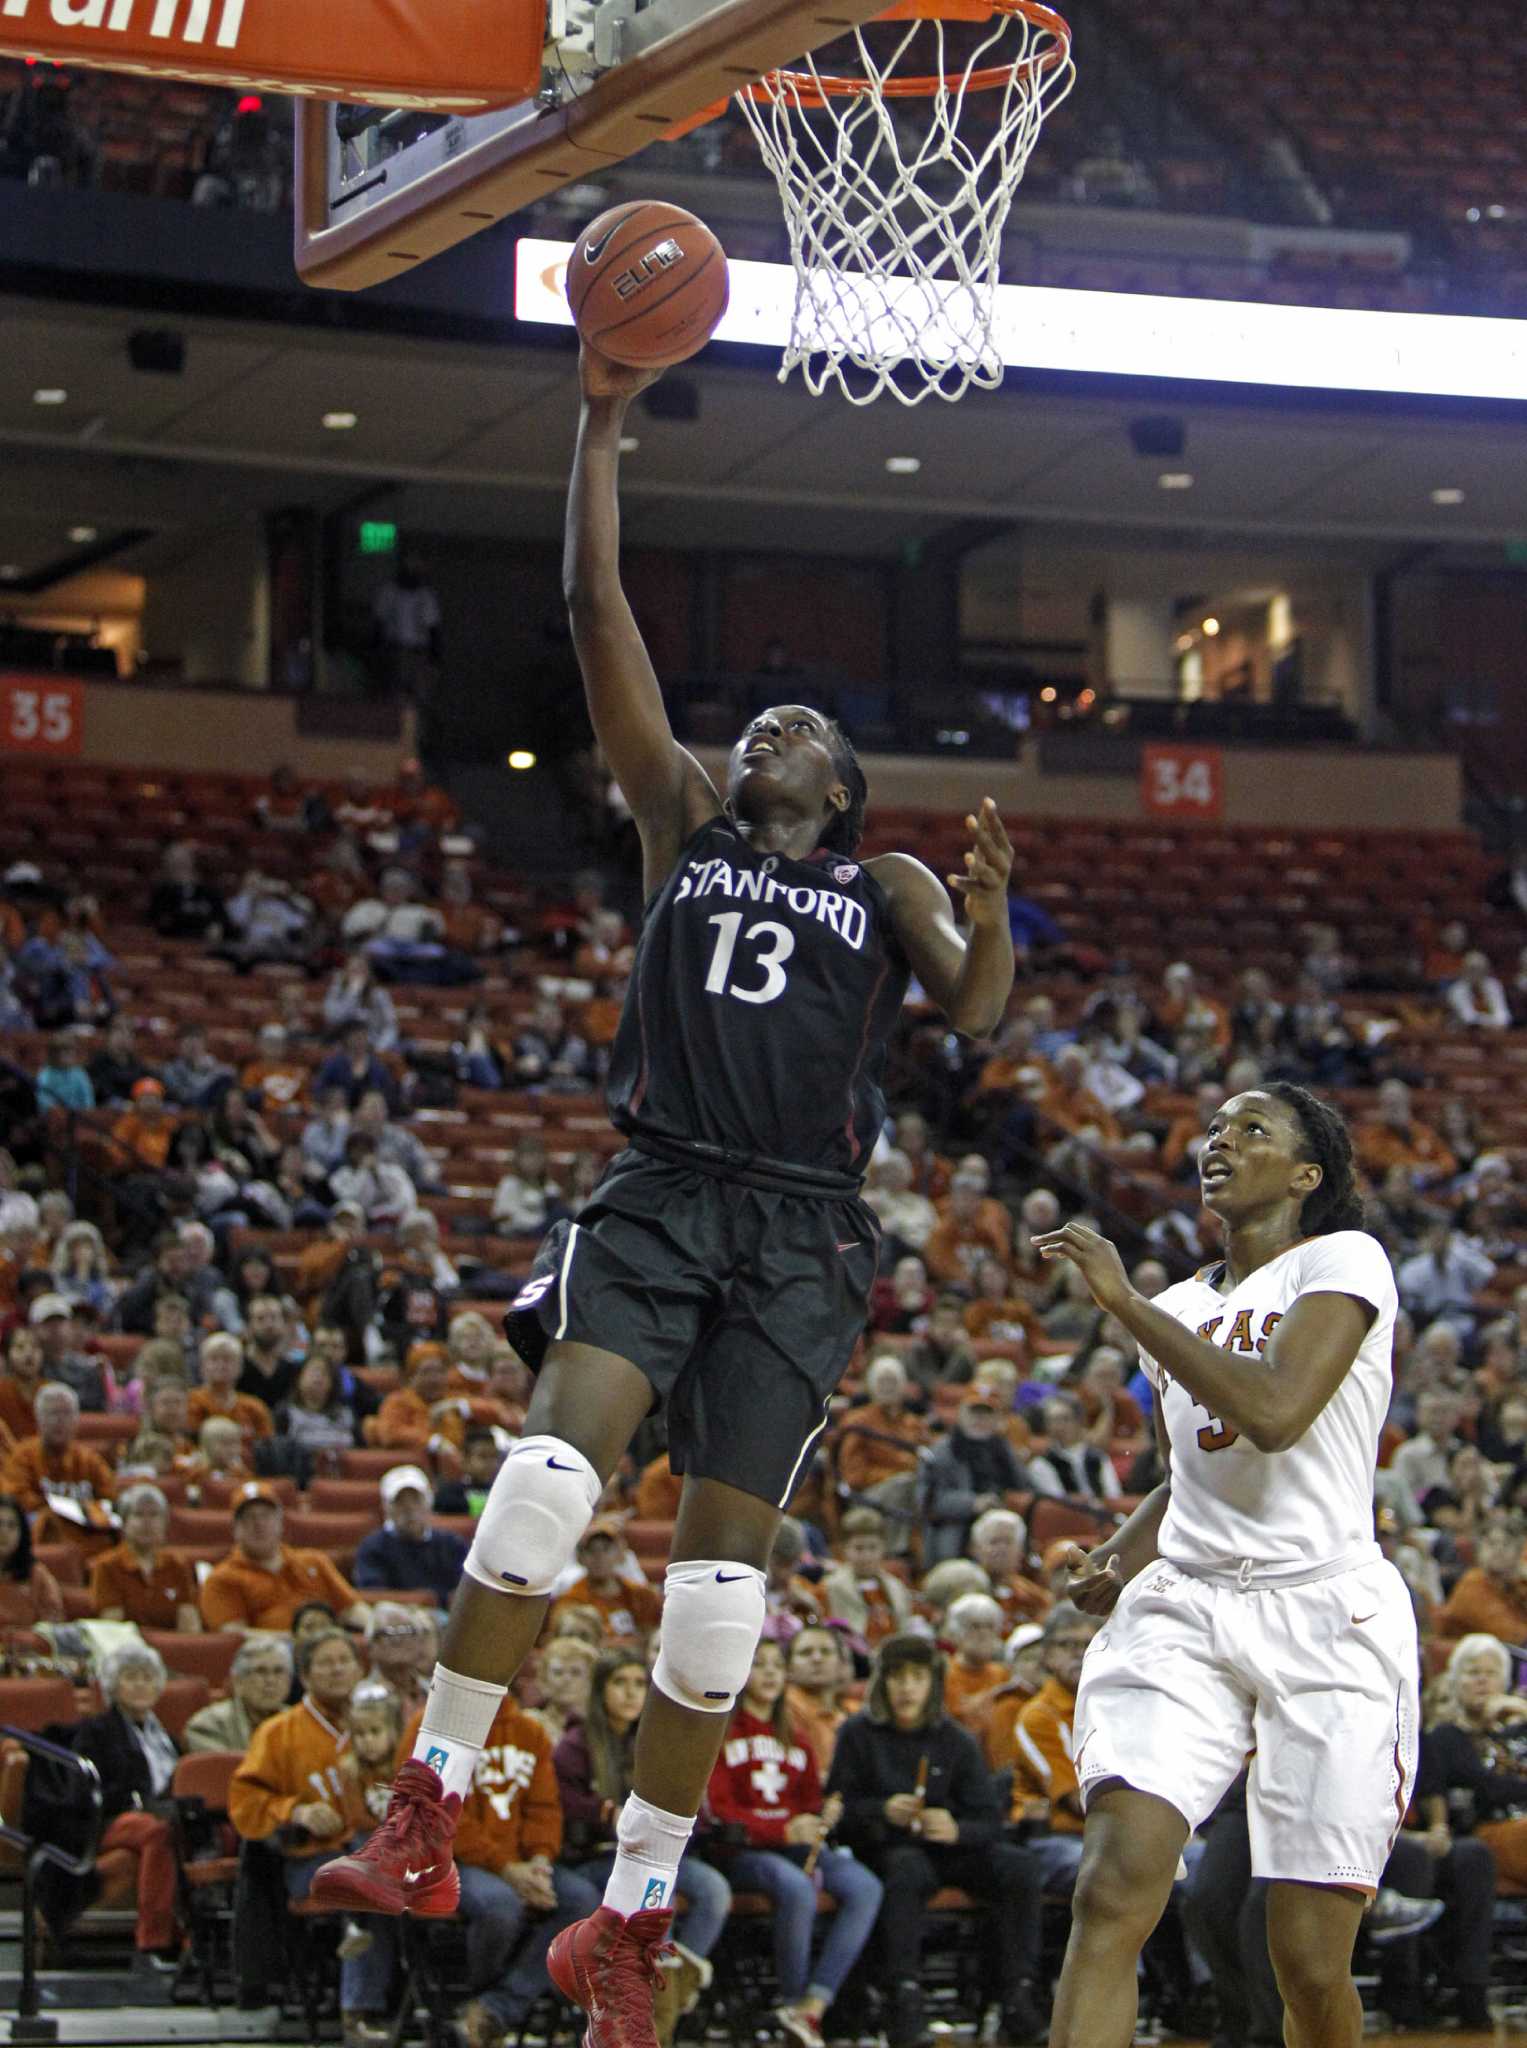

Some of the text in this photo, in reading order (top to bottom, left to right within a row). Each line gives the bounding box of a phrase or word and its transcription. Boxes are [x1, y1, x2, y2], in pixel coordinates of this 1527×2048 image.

[610, 238, 685, 301] ELITE
[10, 690, 72, 742] 35
[1152, 758, 1214, 806] 34
[673, 857, 867, 950] STANFORD
[704, 911, 795, 1005] 13
[1196, 1308, 1286, 1353] XAS
